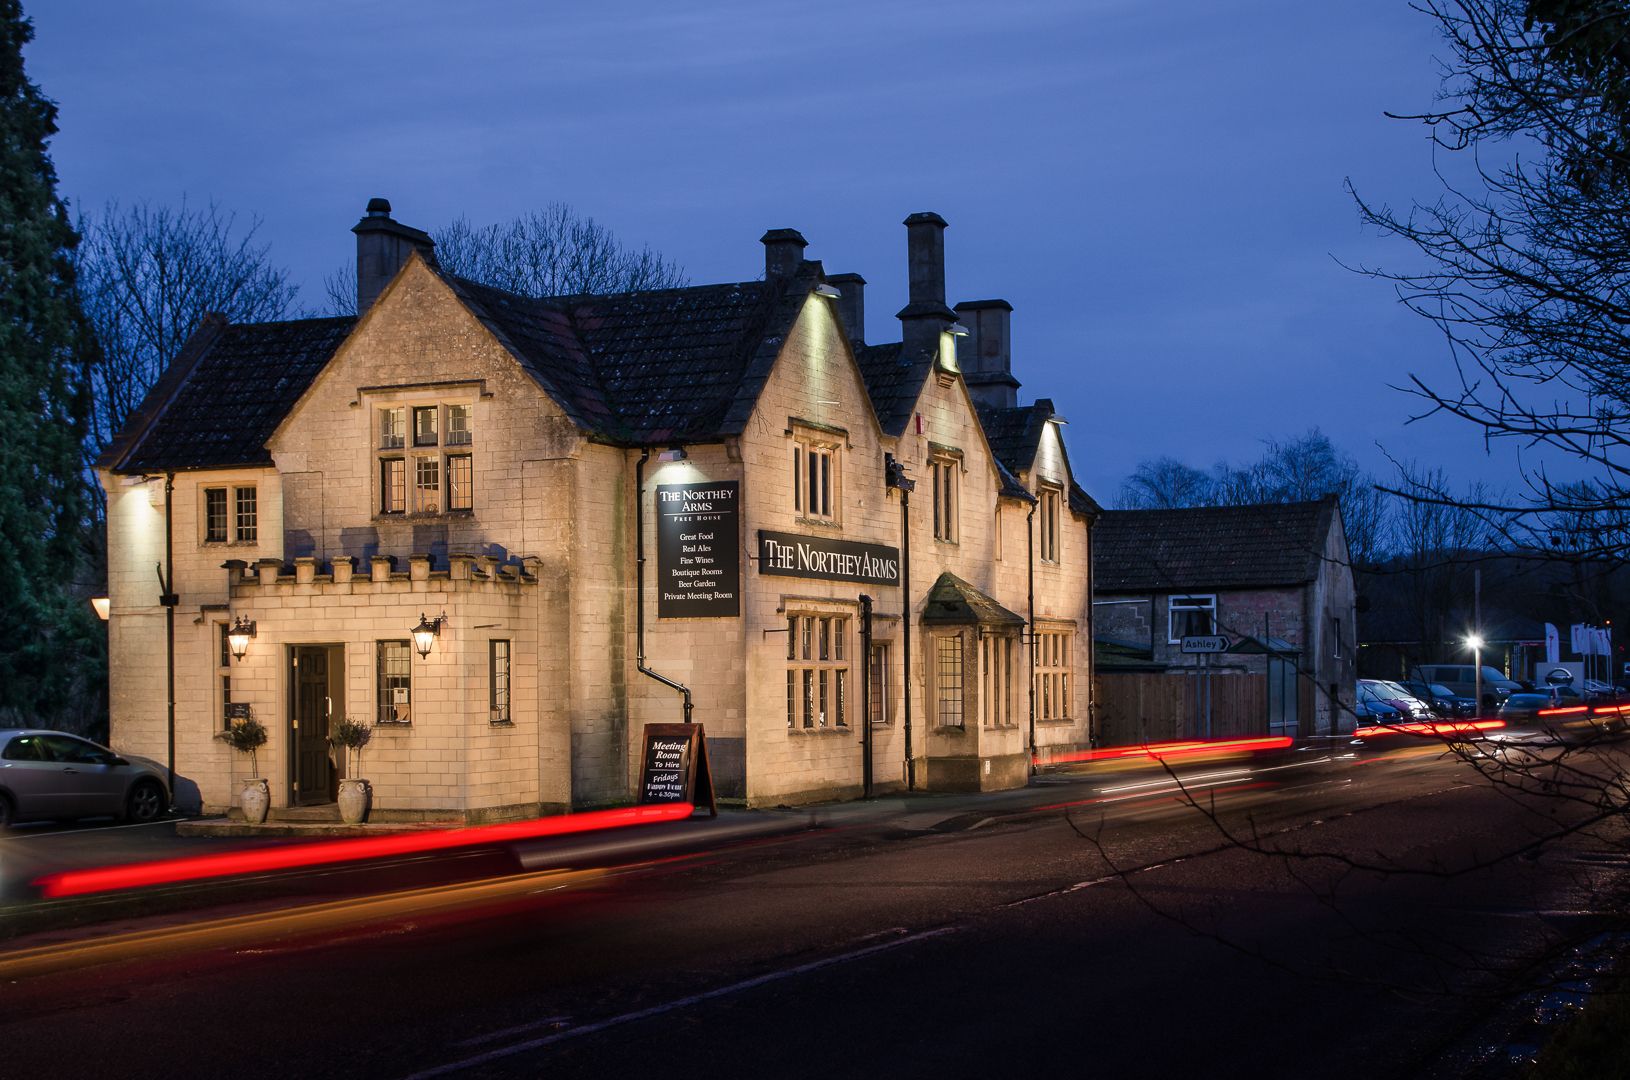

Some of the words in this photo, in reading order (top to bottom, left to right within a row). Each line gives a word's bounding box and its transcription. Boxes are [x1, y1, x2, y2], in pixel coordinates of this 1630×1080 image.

[660, 491, 680, 502] THE
[683, 490, 733, 500] NORTHEY
[682, 502, 712, 512] ARMS
[765, 540, 794, 570] THE
[797, 542, 862, 576] NORTHEY
[862, 552, 897, 580] ARMS
[672, 569, 700, 578] Boutique
[687, 592, 712, 600] Meeting
[1185, 640, 1216, 649] Ashley
[652, 742, 686, 752] Meeting
[656, 751, 680, 760] Room
